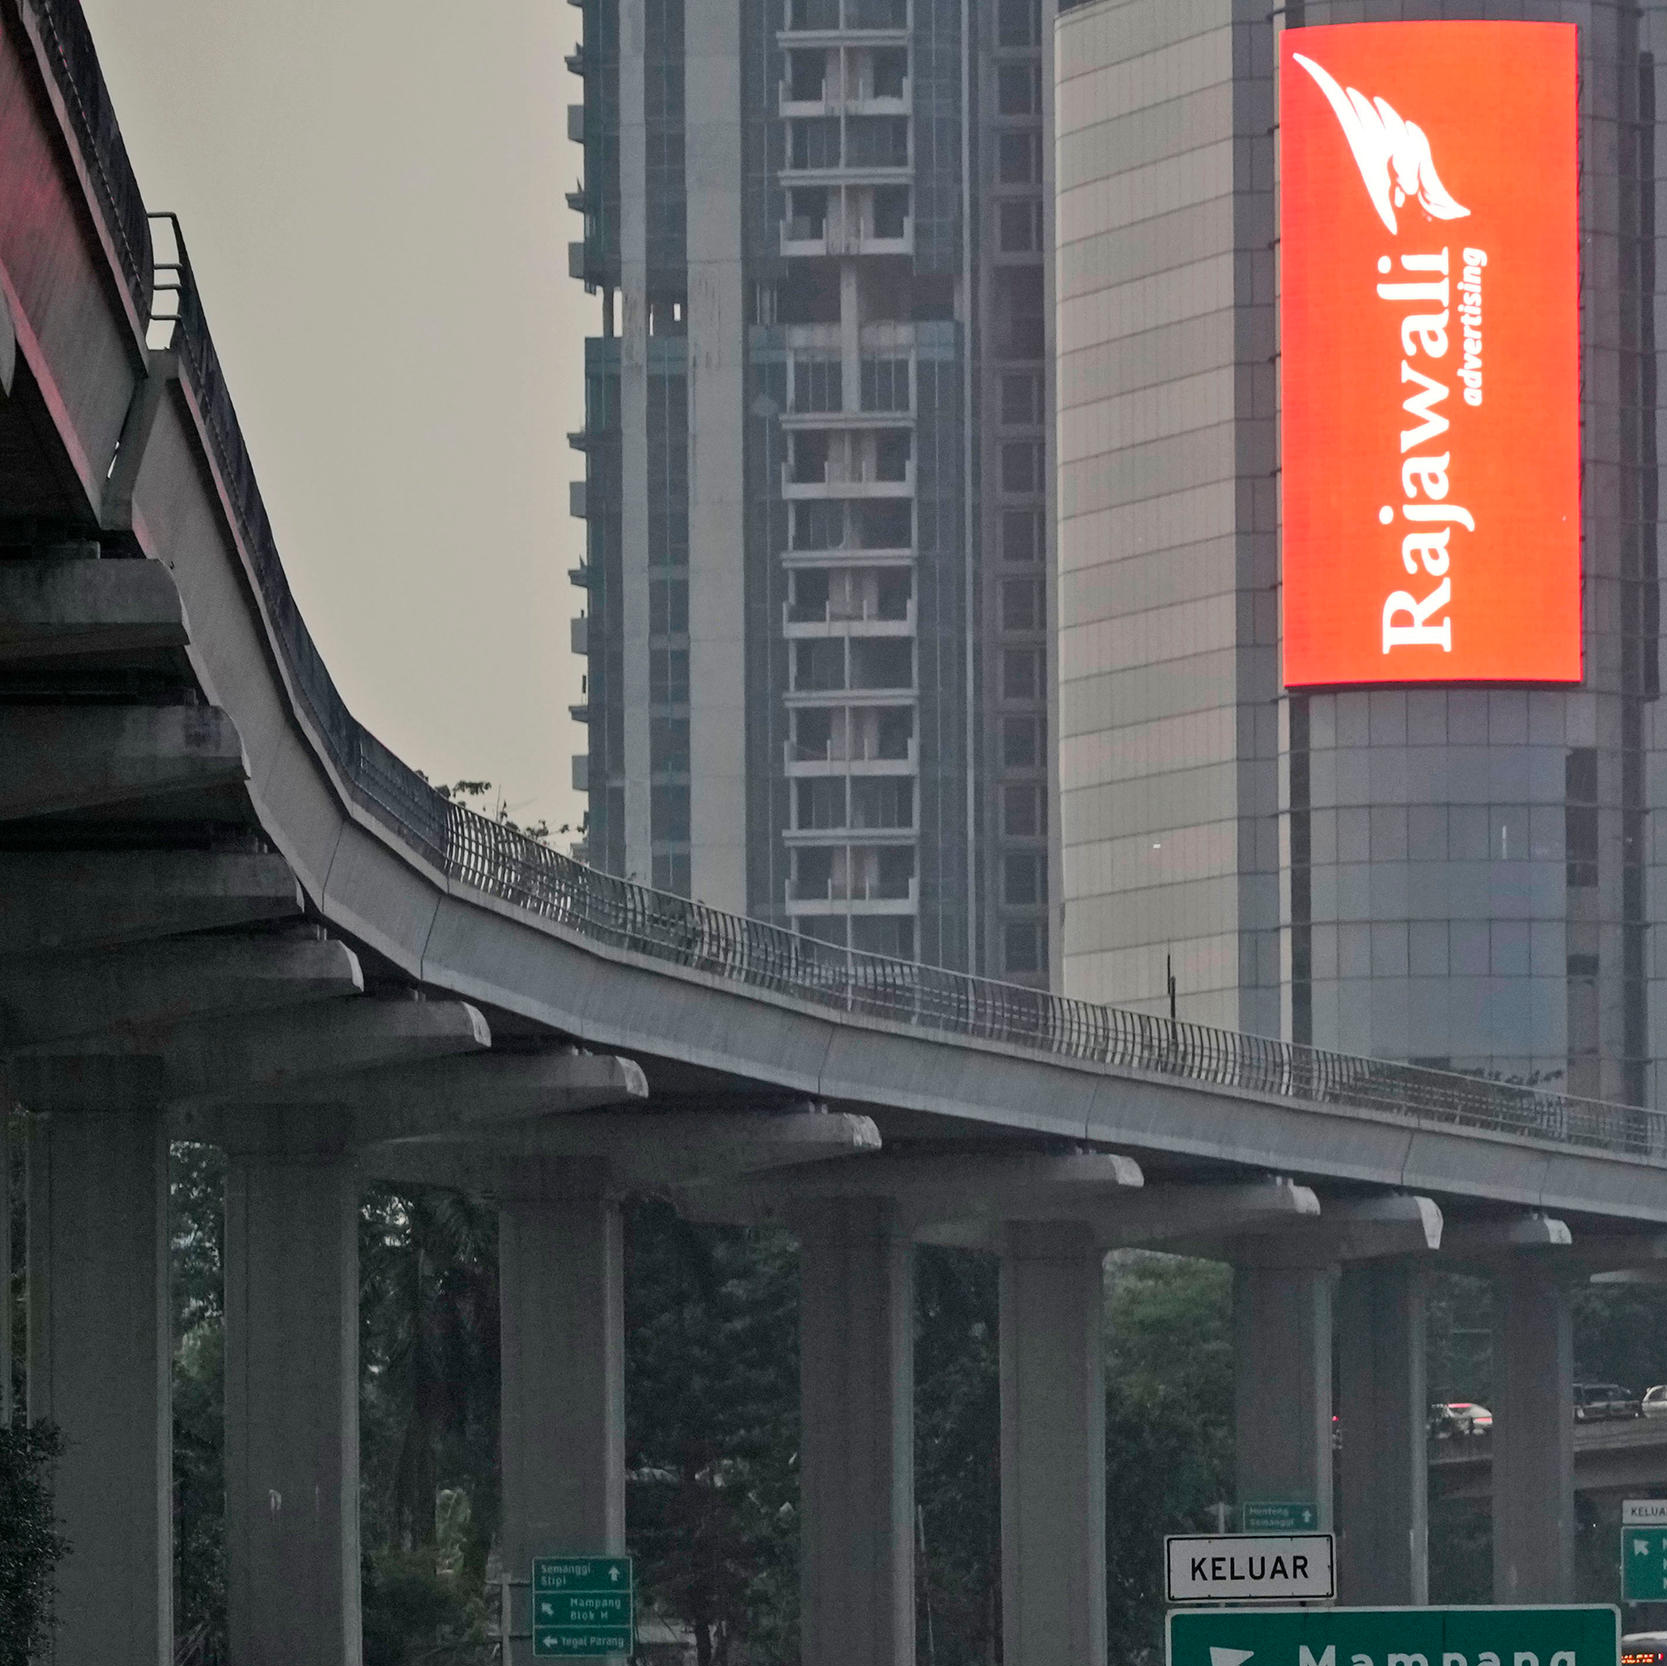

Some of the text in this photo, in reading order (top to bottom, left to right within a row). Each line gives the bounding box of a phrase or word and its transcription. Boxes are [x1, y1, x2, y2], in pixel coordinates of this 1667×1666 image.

[1457, 247, 1486, 407] advertising
[1377, 246, 1473, 655] Rajawali
[541, 1563, 591, 1575] Semanggi
[1191, 1555, 1309, 1581] KELUAR
[541, 1576, 567, 1587] Slipi
[570, 1598, 622, 1609] Mampang
[570, 1610, 595, 1620] Blok
[561, 1636, 625, 1647] Tegal Parang
